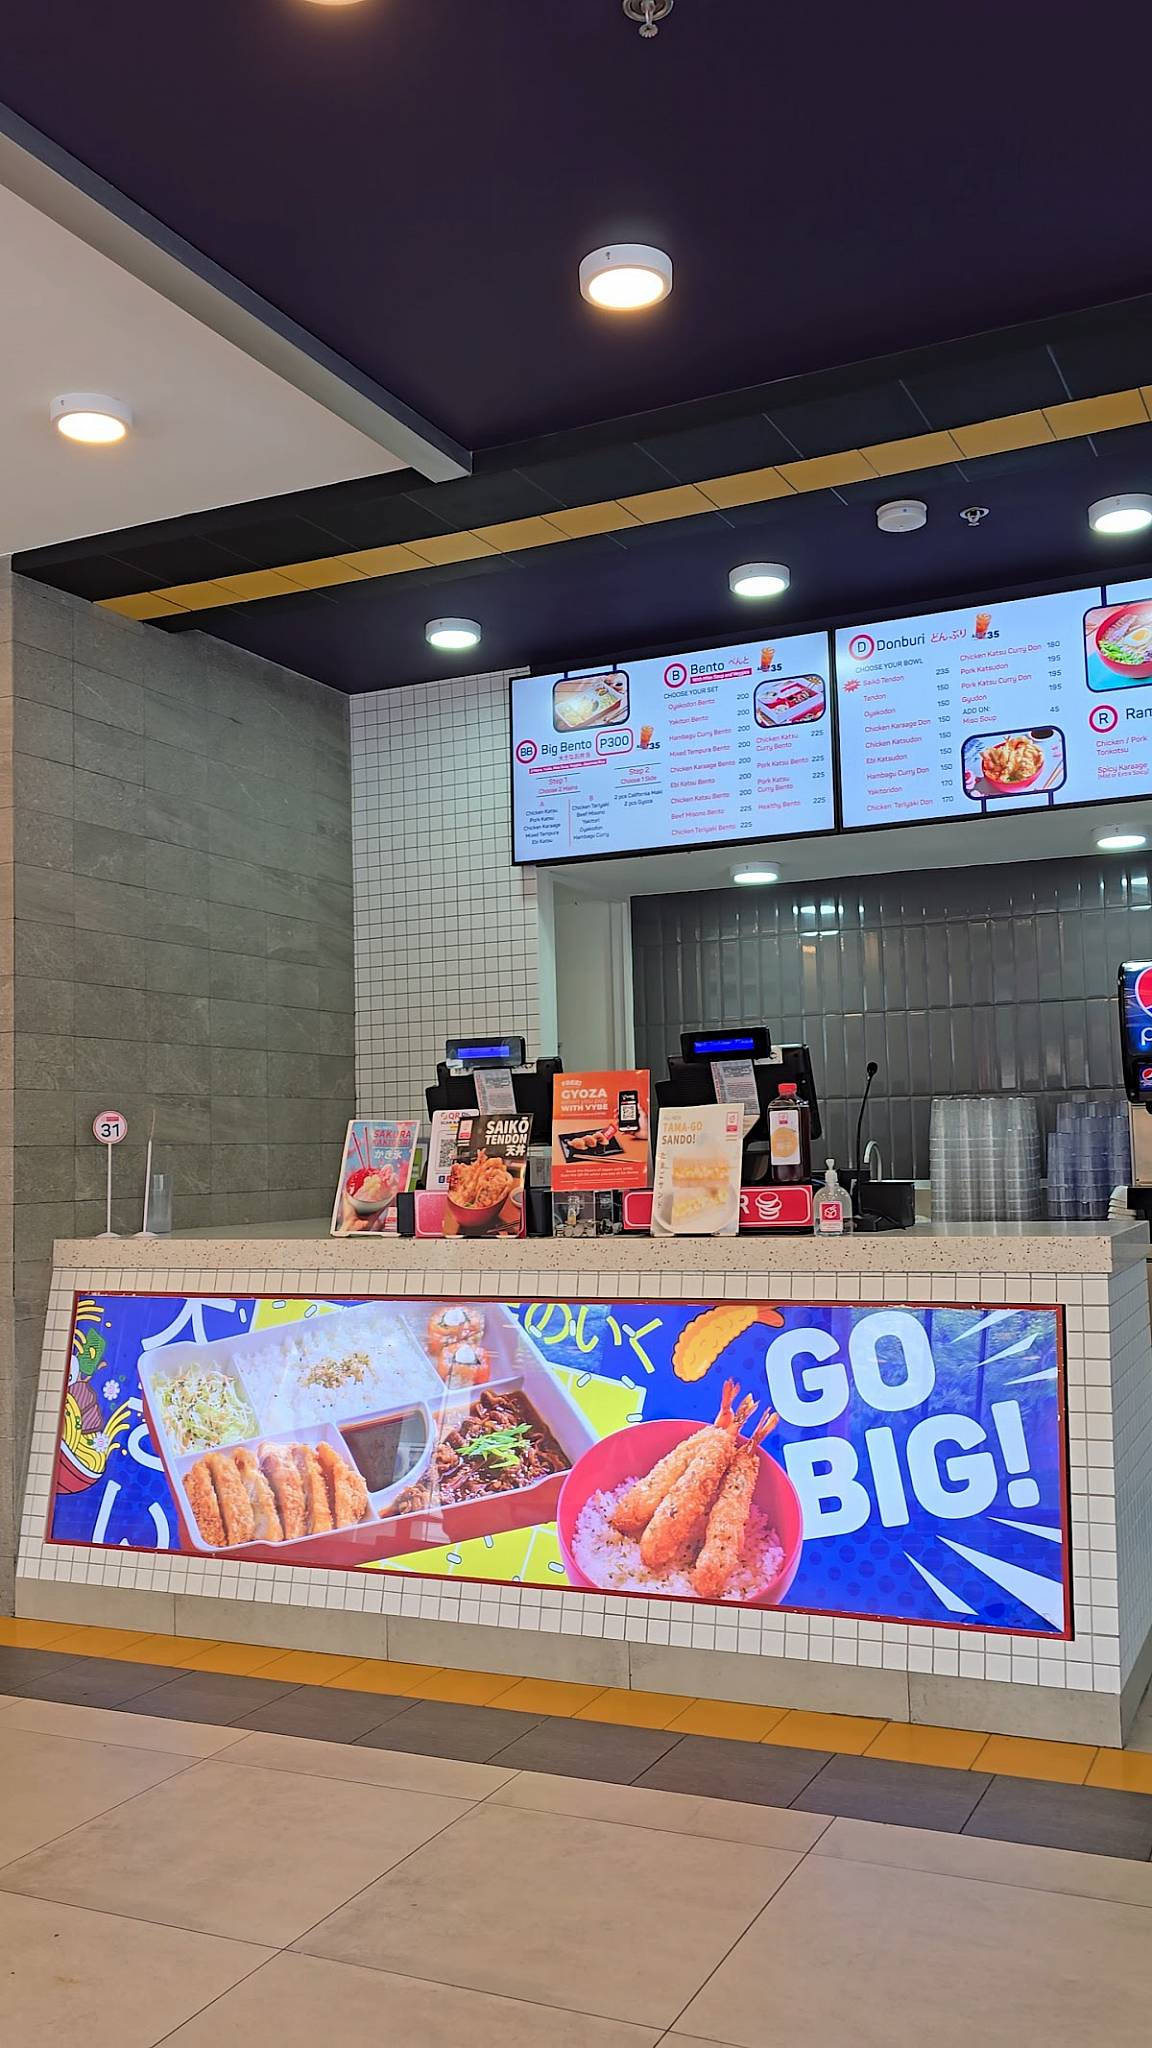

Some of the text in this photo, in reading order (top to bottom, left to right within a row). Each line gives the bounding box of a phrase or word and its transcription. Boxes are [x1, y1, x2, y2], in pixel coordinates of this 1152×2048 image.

[877, 633, 925, 650] Donburi
[858, 642, 866, 652] D
[960, 653, 986, 661] Chicken
[691, 662, 724, 674] Bento
[856, 665, 882, 674] CHOOSE
[904, 658, 923, 666] BOWL
[977, 663, 1008, 672] Katsudon
[673, 671, 679, 680] B
[881, 675, 904, 684] Tendon
[664, 691, 688, 699] CHOOSE
[962, 695, 987, 703] Gyudon
[668, 702, 696, 710] Oyakodon
[864, 708, 895, 718] Oyakodon
[1099, 713, 1108, 724] R
[865, 724, 890, 732] Chicken
[891, 721, 916, 729] Karaage
[600, 735, 629, 748] P300
[892, 736, 922, 744] Katsudon
[521, 746, 533, 756] BB
[542, 741, 592, 756] Big Bento
[688, 747, 712, 755] Tempura
[877, 754, 907, 762] Katsudon
[694, 763, 717, 771] Karaage
[898, 769, 915, 777] Curry
[758, 802, 781, 810] Healthy
[696, 826, 717, 834] Teriyaki
[561, 1088, 607, 1099] GYOZA
[101, 1124, 119, 1137] 31
[485, 1116, 529, 1135] SAIKŌ
[663, 1121, 702, 1132] TAMA-GO
[373, 1129, 411, 1139] SAKURA
[485, 1134, 527, 1144] TENDON
[662, 1134, 695, 1145] SANDO!
[765, 1310, 935, 1427] GO
[783, 1400, 1039, 1540] BIG!
